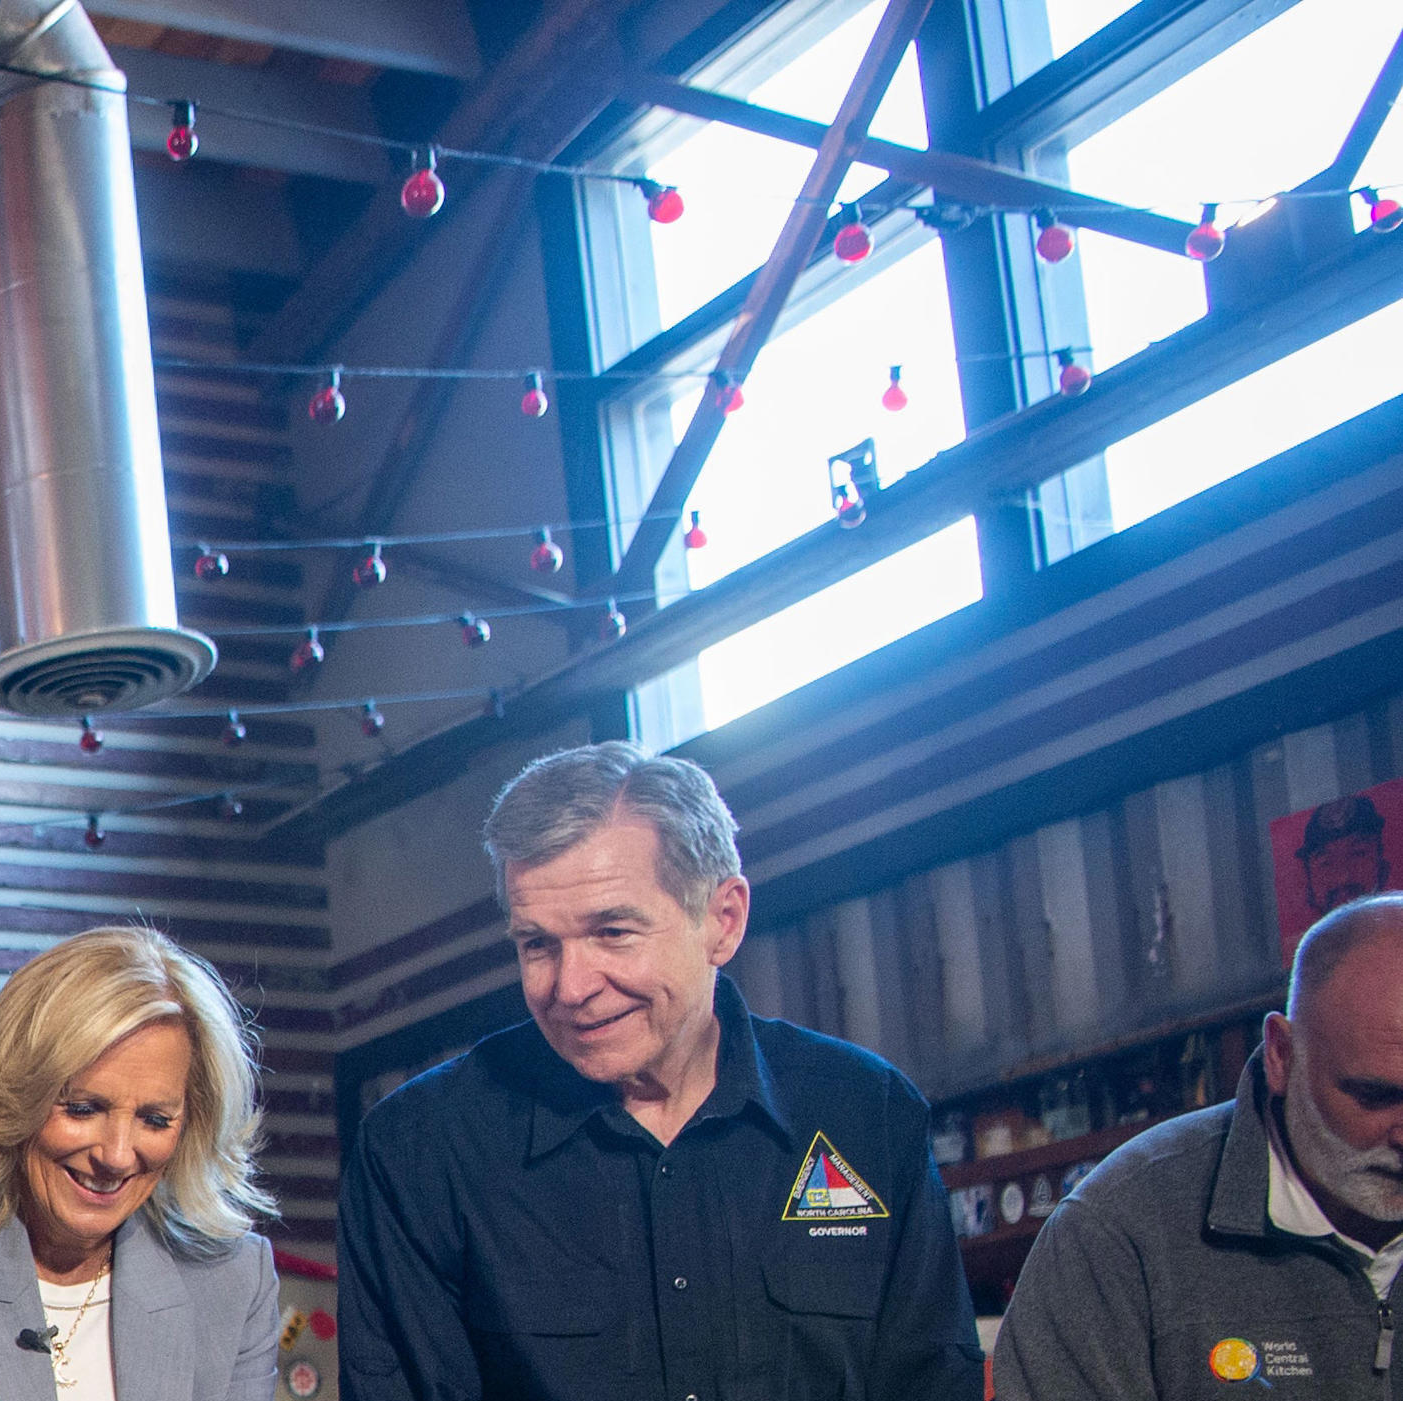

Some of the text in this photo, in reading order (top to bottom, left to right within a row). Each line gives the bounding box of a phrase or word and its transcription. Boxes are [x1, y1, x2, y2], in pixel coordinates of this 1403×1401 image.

[828, 1153, 874, 1201] MANAGEMENT
[796, 1206, 873, 1217] NORTH CAROLINA
[808, 1226, 868, 1237] GOVERNOR
[1261, 1341, 1298, 1352] World
[1265, 1353, 1309, 1364] Central
[1266, 1366, 1313, 1377] Kitchen
